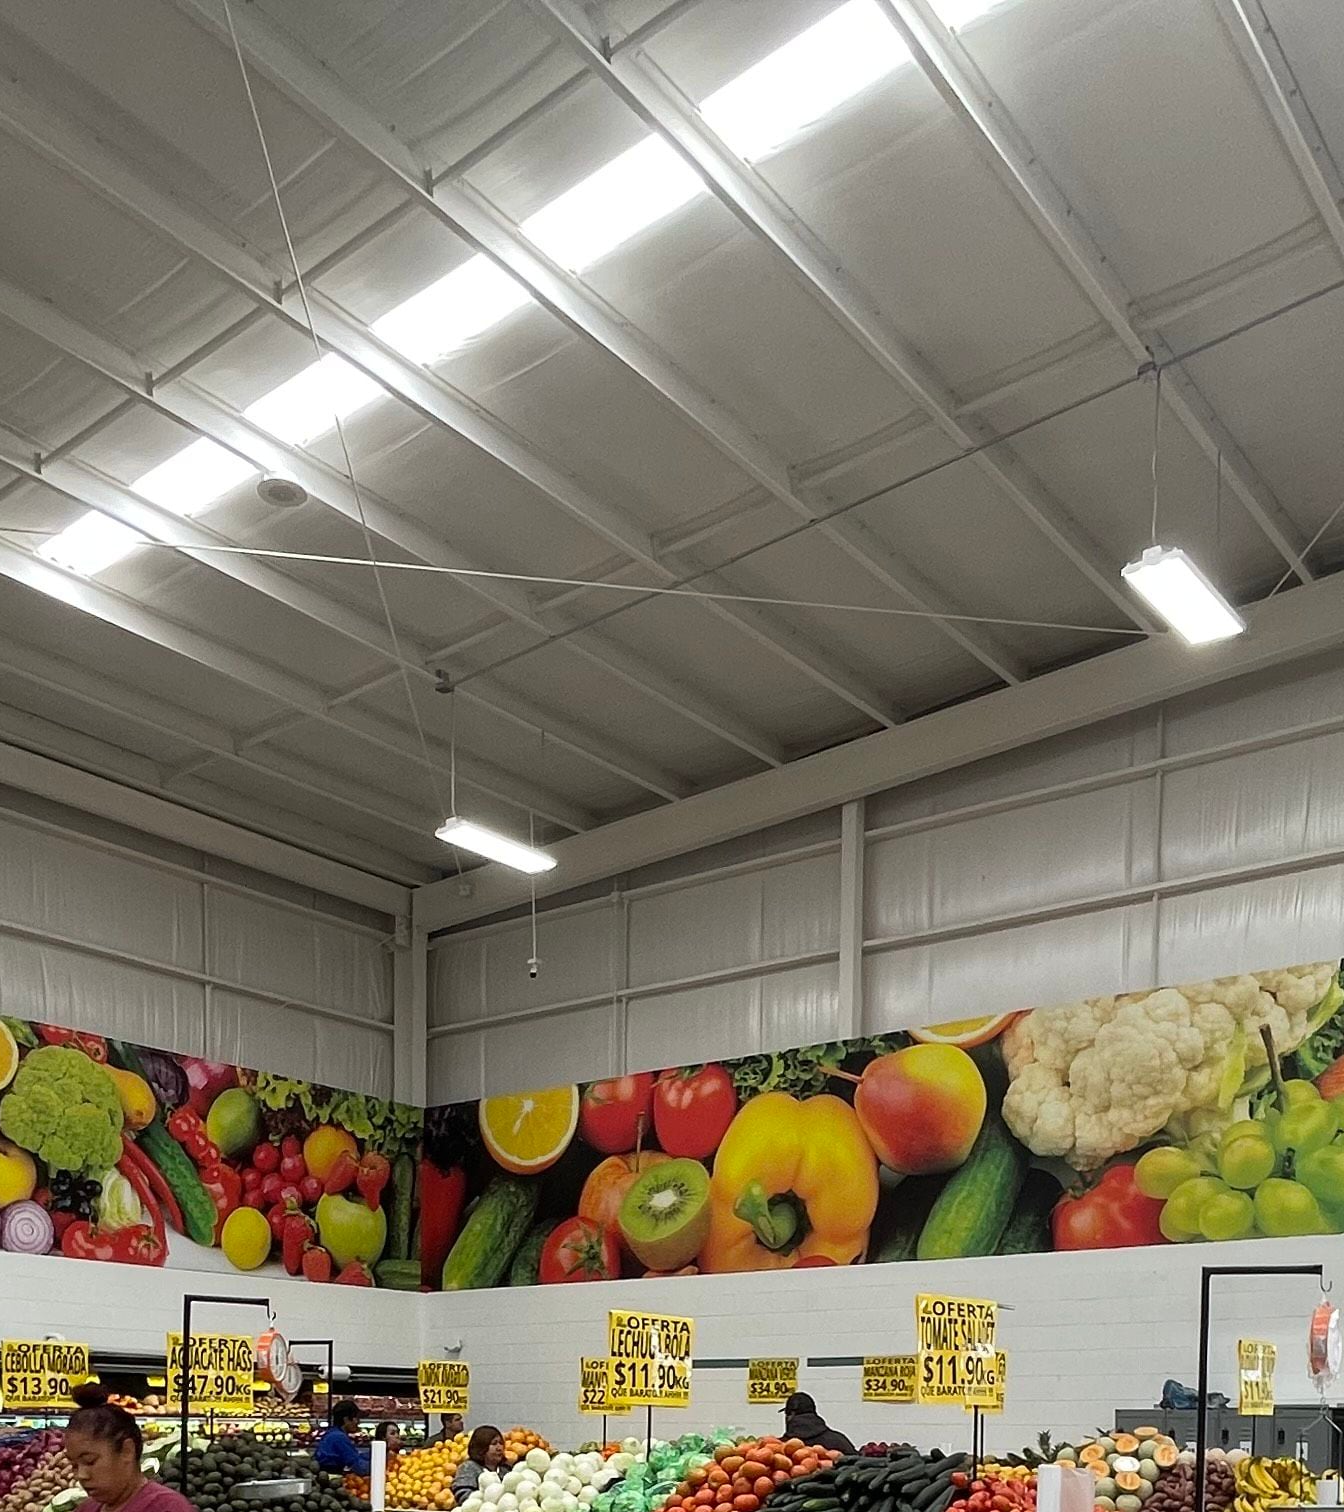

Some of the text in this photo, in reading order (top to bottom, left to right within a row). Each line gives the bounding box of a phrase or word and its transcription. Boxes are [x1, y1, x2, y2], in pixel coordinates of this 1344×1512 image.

[933, 1300, 994, 1320] OFERTA
[627, 1316, 690, 1334] OFERTA
[18, 1343, 85, 1355] OFERTA
